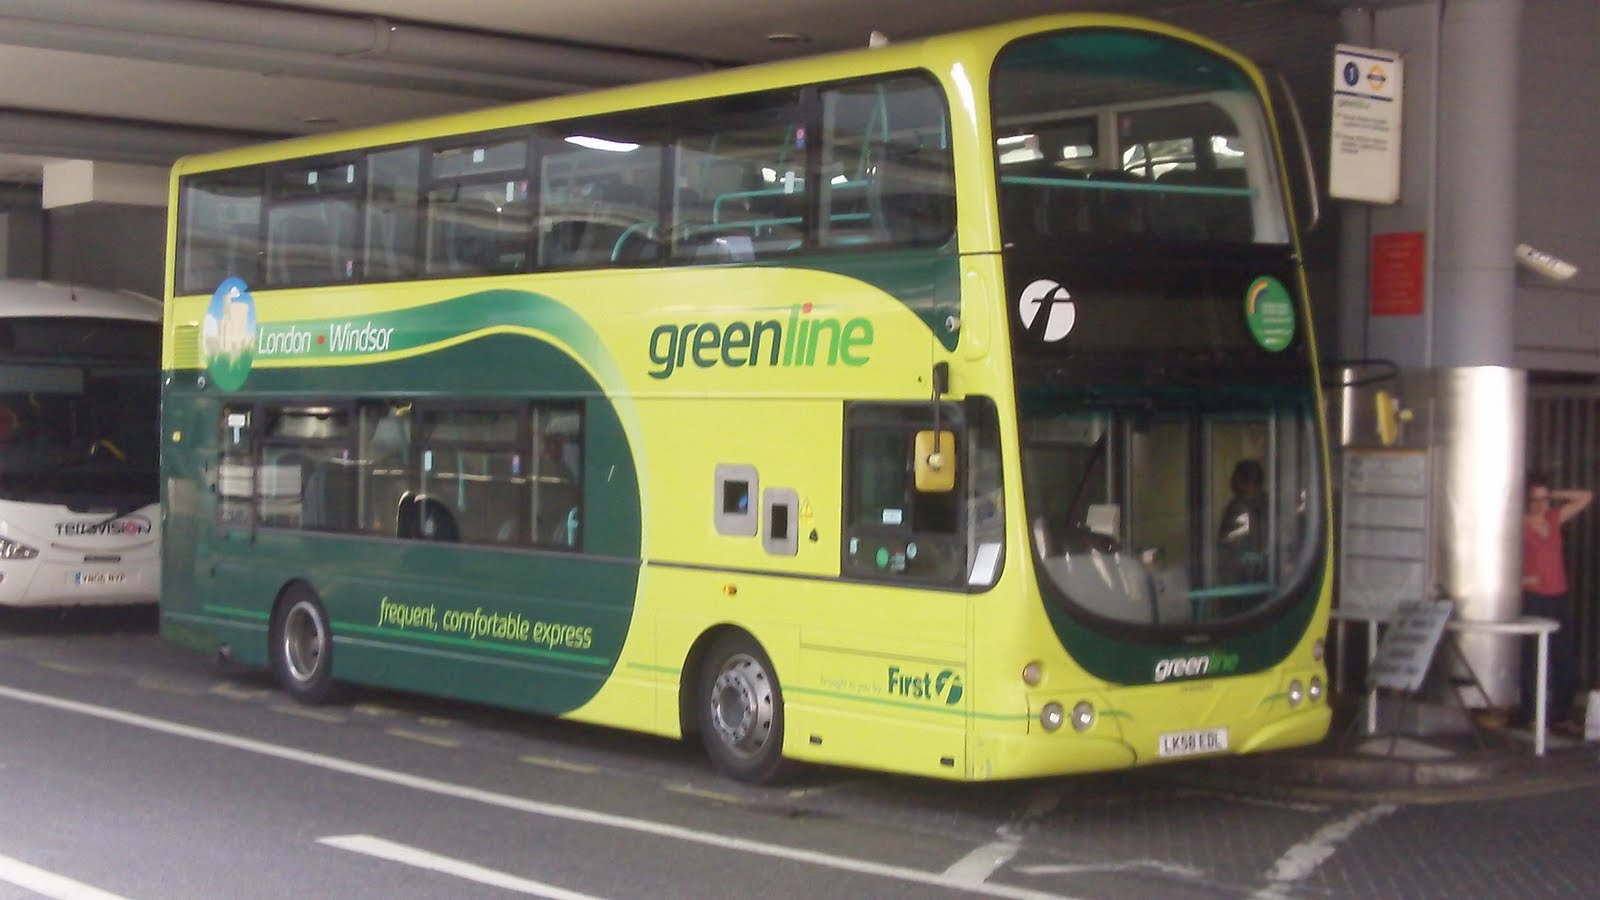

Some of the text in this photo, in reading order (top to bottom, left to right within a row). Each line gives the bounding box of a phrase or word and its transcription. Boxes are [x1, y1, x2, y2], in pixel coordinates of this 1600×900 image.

[258, 321, 395, 354] London Windsor
[647, 302, 875, 380] greenline
[378, 596, 593, 650] frequent, comfortable express
[888, 665, 932, 700] First
